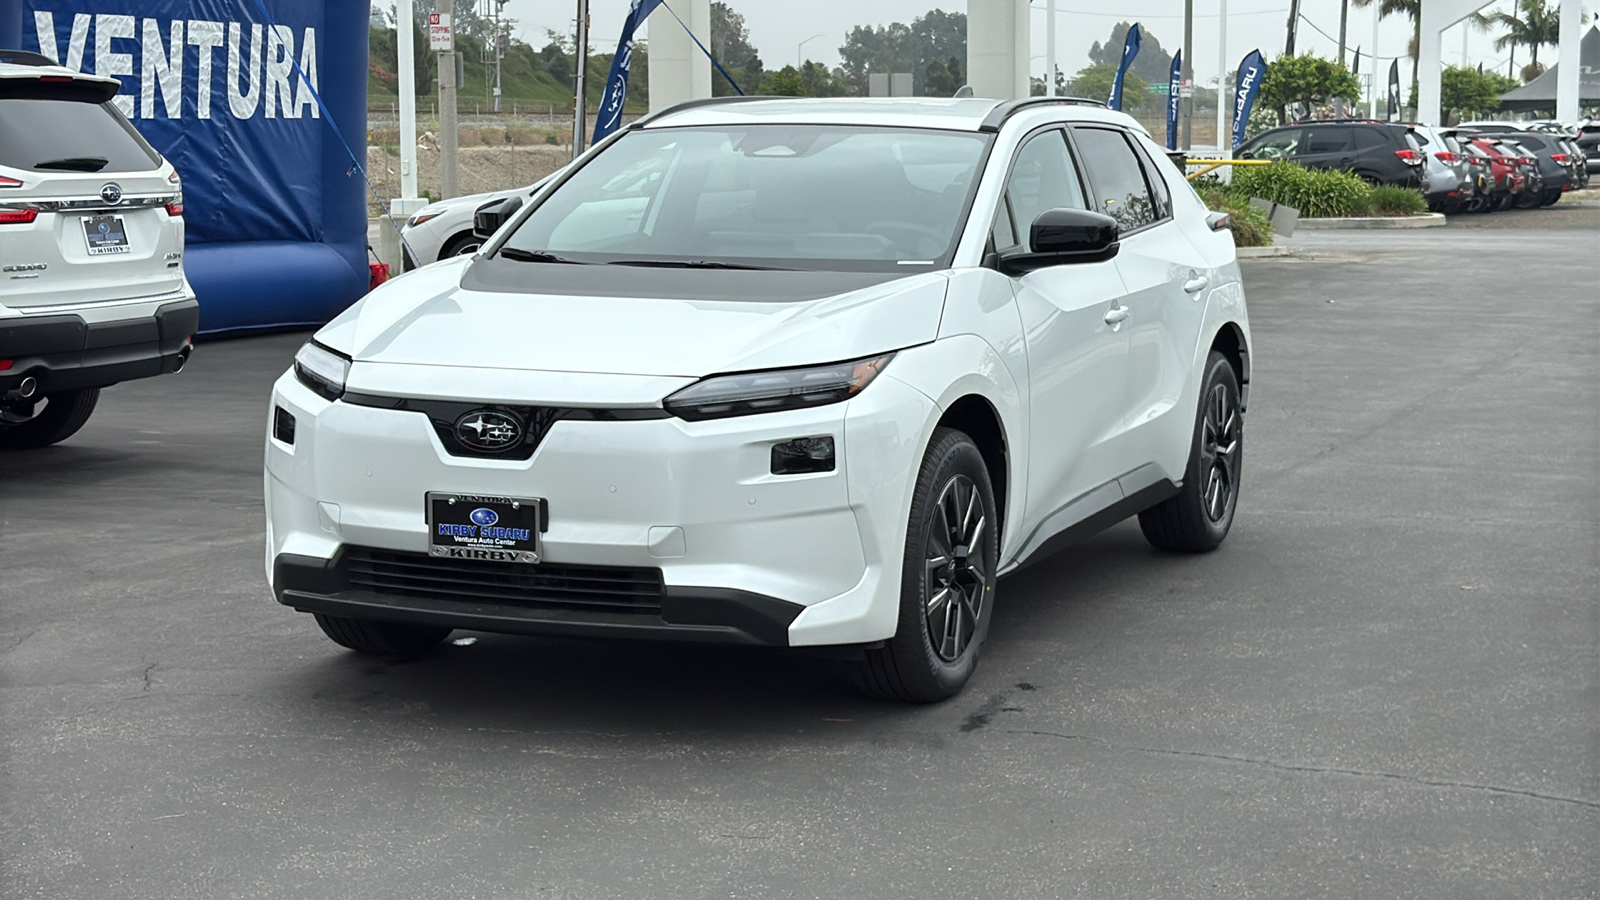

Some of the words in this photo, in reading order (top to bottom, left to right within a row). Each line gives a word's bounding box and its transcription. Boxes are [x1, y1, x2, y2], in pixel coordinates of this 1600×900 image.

[430, 14, 439, 24] NO
[34, 11, 320, 119] VENTURA
[456, 494, 513, 503] VENTURA
[439, 524, 477, 536] KIRBY
[480, 526, 530, 541] SUBARU
[454, 535, 478, 543] Ventura
[478, 537, 494, 545] Auto
[494, 538, 516, 546] Center
[450, 548, 520, 561] KIRBY
